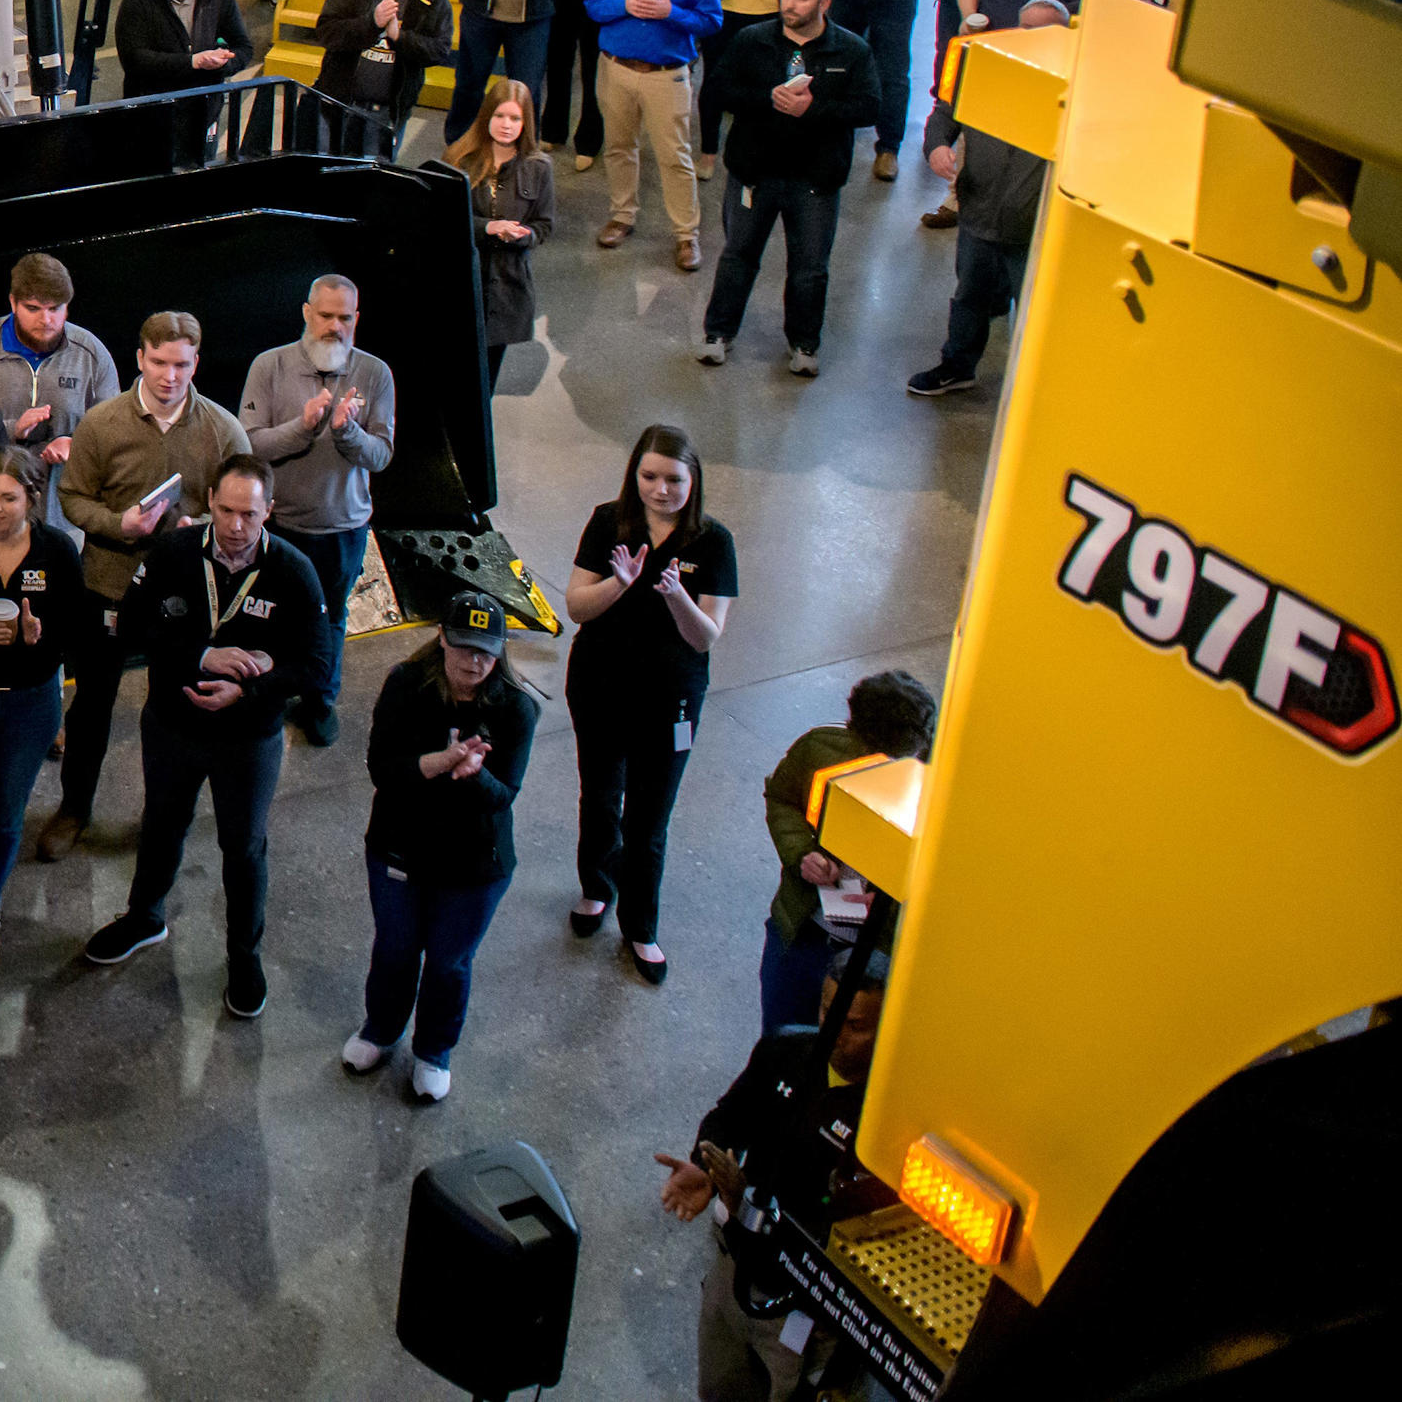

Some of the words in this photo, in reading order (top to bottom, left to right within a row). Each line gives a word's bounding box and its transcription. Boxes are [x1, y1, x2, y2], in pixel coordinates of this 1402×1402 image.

[59, 376, 78, 390] CAT
[22, 570, 46, 580] 100
[680, 561, 699, 574] CAT
[1062, 477, 1342, 711] 797F
[242, 596, 275, 619] CAT
[831, 1119, 853, 1141] CAT
[779, 1250, 809, 1289] Please
[810, 1285, 822, 1303] do
[823, 1298, 840, 1321] not
[841, 1314, 869, 1349] Climb
[870, 1347, 883, 1364] on
[884, 1360, 901, 1382] the
[801, 1251, 818, 1274] For
[819, 1271, 836, 1292] the
[836, 1286, 869, 1327] Safety
[870, 1322, 882, 1338] of
[882, 1333, 902, 1358] Our
[904, 1352, 938, 1393] Visitor
